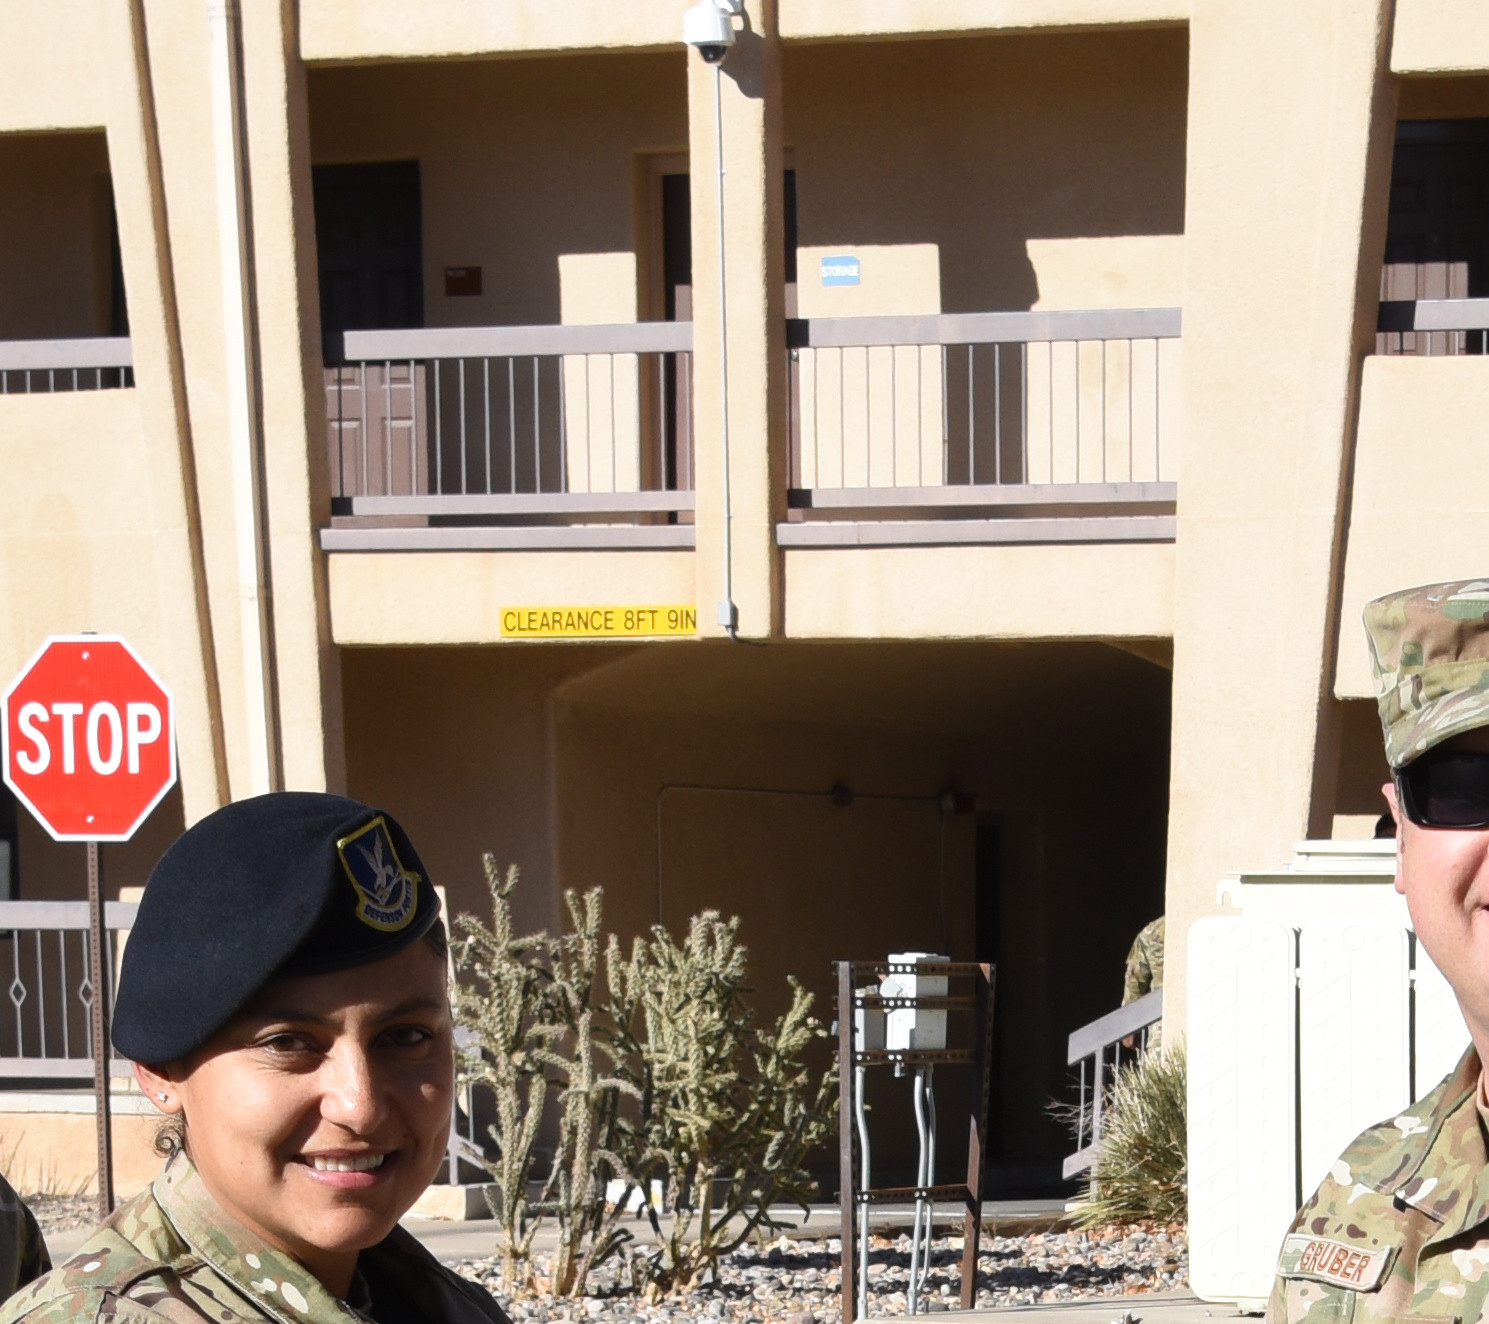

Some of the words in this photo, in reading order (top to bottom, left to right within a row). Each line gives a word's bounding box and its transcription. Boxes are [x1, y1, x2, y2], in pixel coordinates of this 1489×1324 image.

[504, 610, 614, 631] CLEARANCE
[623, 610, 658, 631] 8FT
[667, 609, 697, 630] 9IN
[16, 701, 162, 775] STOP
[1300, 1241, 1371, 1282] GRUBER
